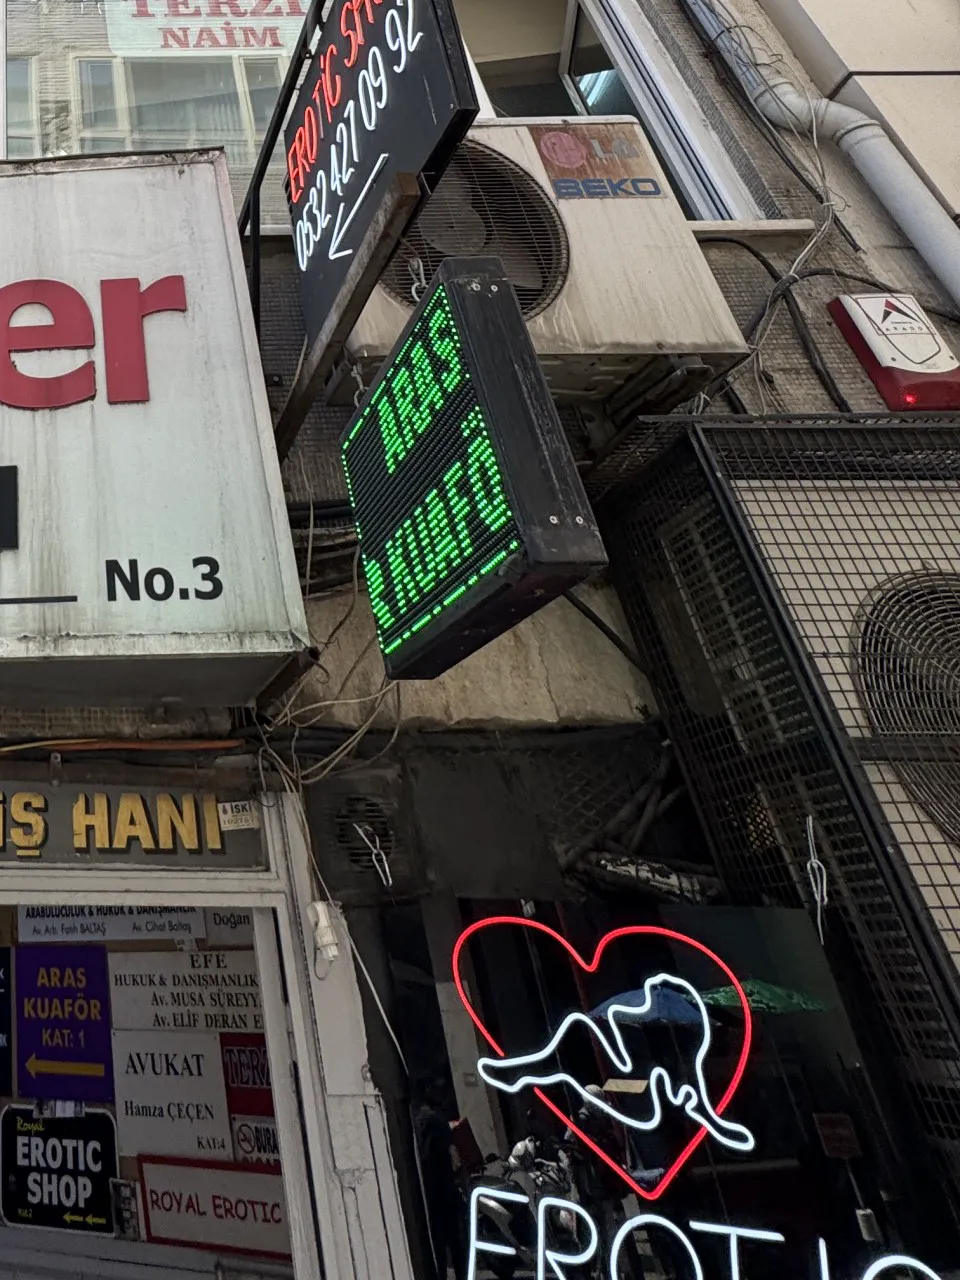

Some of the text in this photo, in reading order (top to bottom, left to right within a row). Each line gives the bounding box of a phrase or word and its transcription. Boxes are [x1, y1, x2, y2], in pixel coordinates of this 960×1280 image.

[157, 21, 285, 49] NAİM
[295, 169, 332, 272] 0532
[357, 45, 388, 131] 09
[552, 177, 662, 197] BEKO
[104, 555, 224, 603] No.3
[71, 791, 227, 854] HANI
[213, 911, 251, 929] Doğan
[190, 953, 228, 969] EFE
[36, 967, 88, 989] ARAS
[114, 973, 260, 989] HUKUK & DANIŞMANLIK
[23, 991, 102, 1021] KUAFÖR
[151, 988, 262, 1008] Av. MUSA SÜREYY
[152, 1013, 170, 1027] Av.
[173, 1009, 200, 1028] ELİF
[205, 1013, 249, 1029] DERAN
[78, 1028, 86, 1049] 1
[125, 1052, 205, 1077] AVUKAT
[124, 1100, 215, 1124] Hamza ÇEÇEN
[16, 1135, 103, 1173] EROTIC
[26, 1171, 93, 1210] SHOP
[149, 1187, 207, 1217] ROYAL
[211, 1194, 283, 1225] EROTIC
[467, 1185, 944, 1280] EROT
